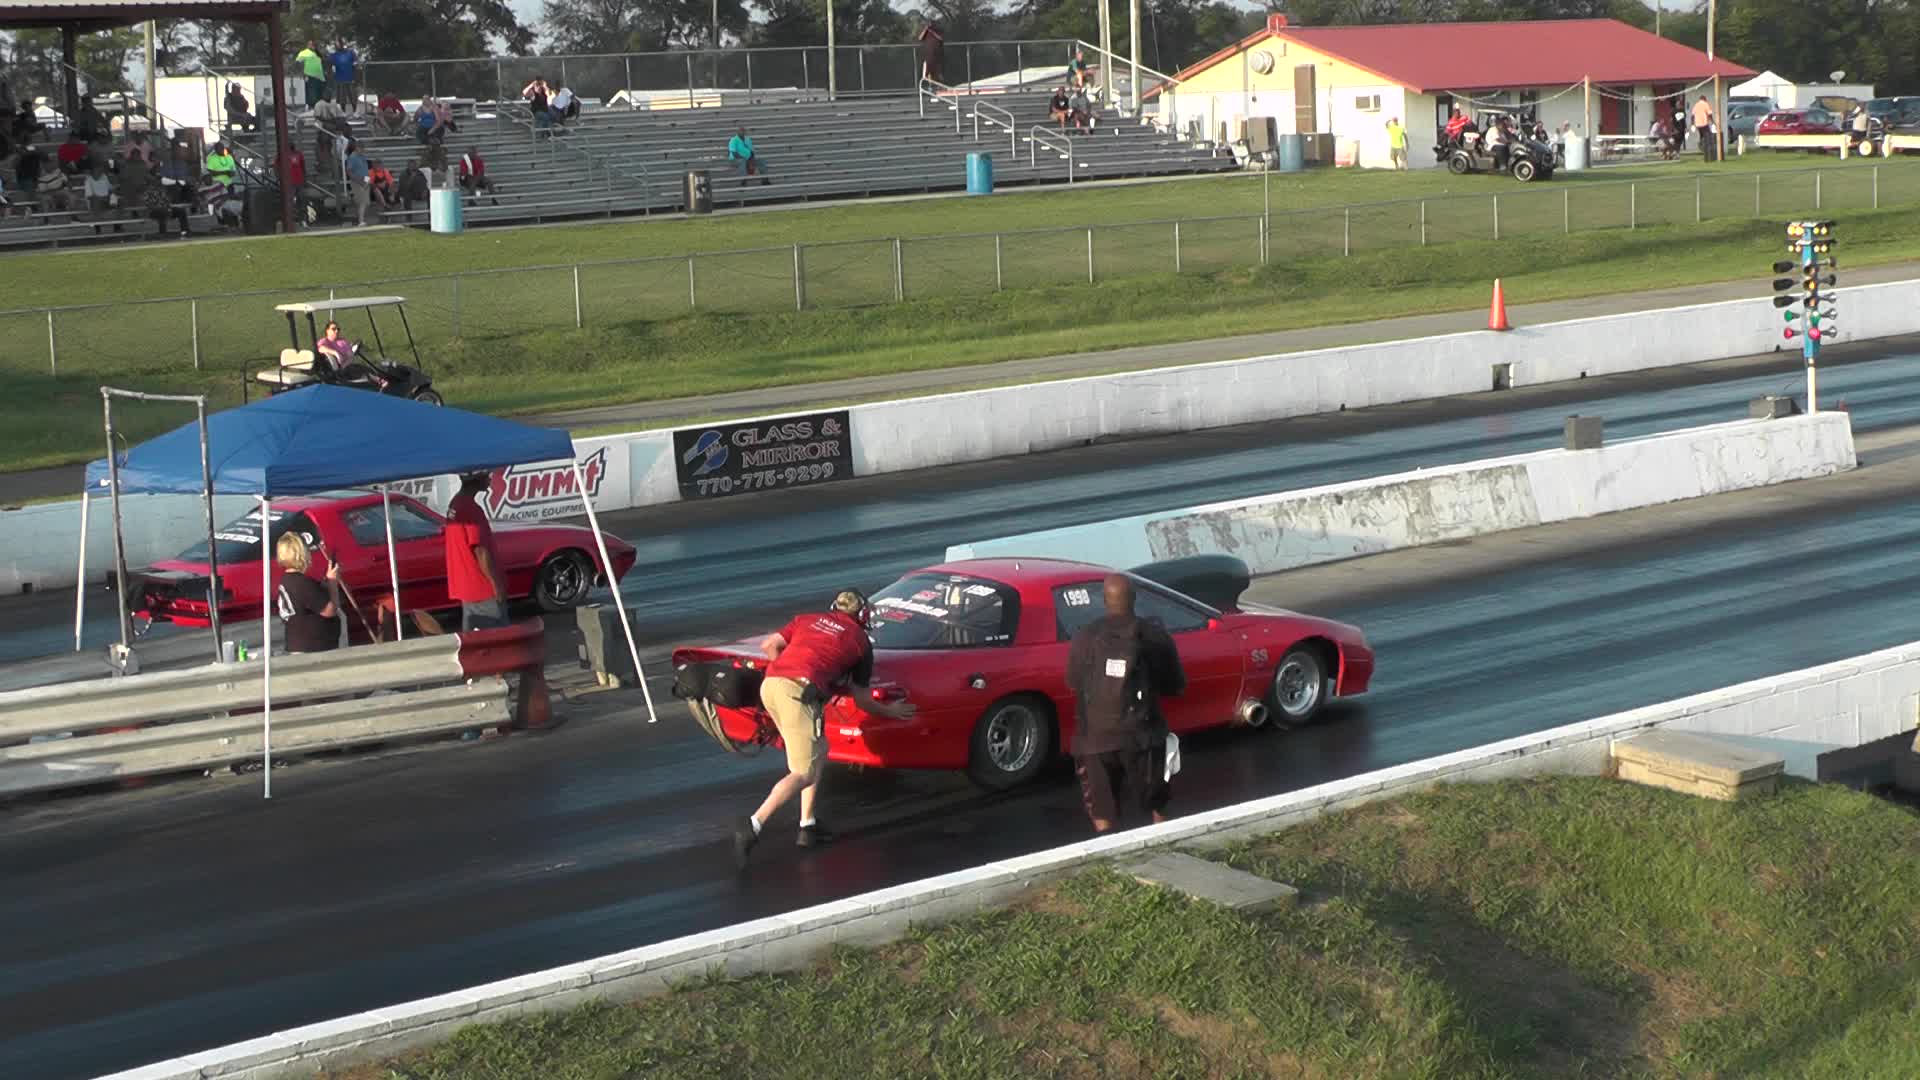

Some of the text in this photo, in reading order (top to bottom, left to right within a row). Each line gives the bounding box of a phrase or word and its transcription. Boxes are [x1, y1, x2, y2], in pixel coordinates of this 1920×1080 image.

[731, 418, 843, 447] GLASS &
[741, 440, 841, 468] MIRROR
[697, 462, 835, 496] 770-775-9299
[541, 501, 599, 518] EQUIPMET
